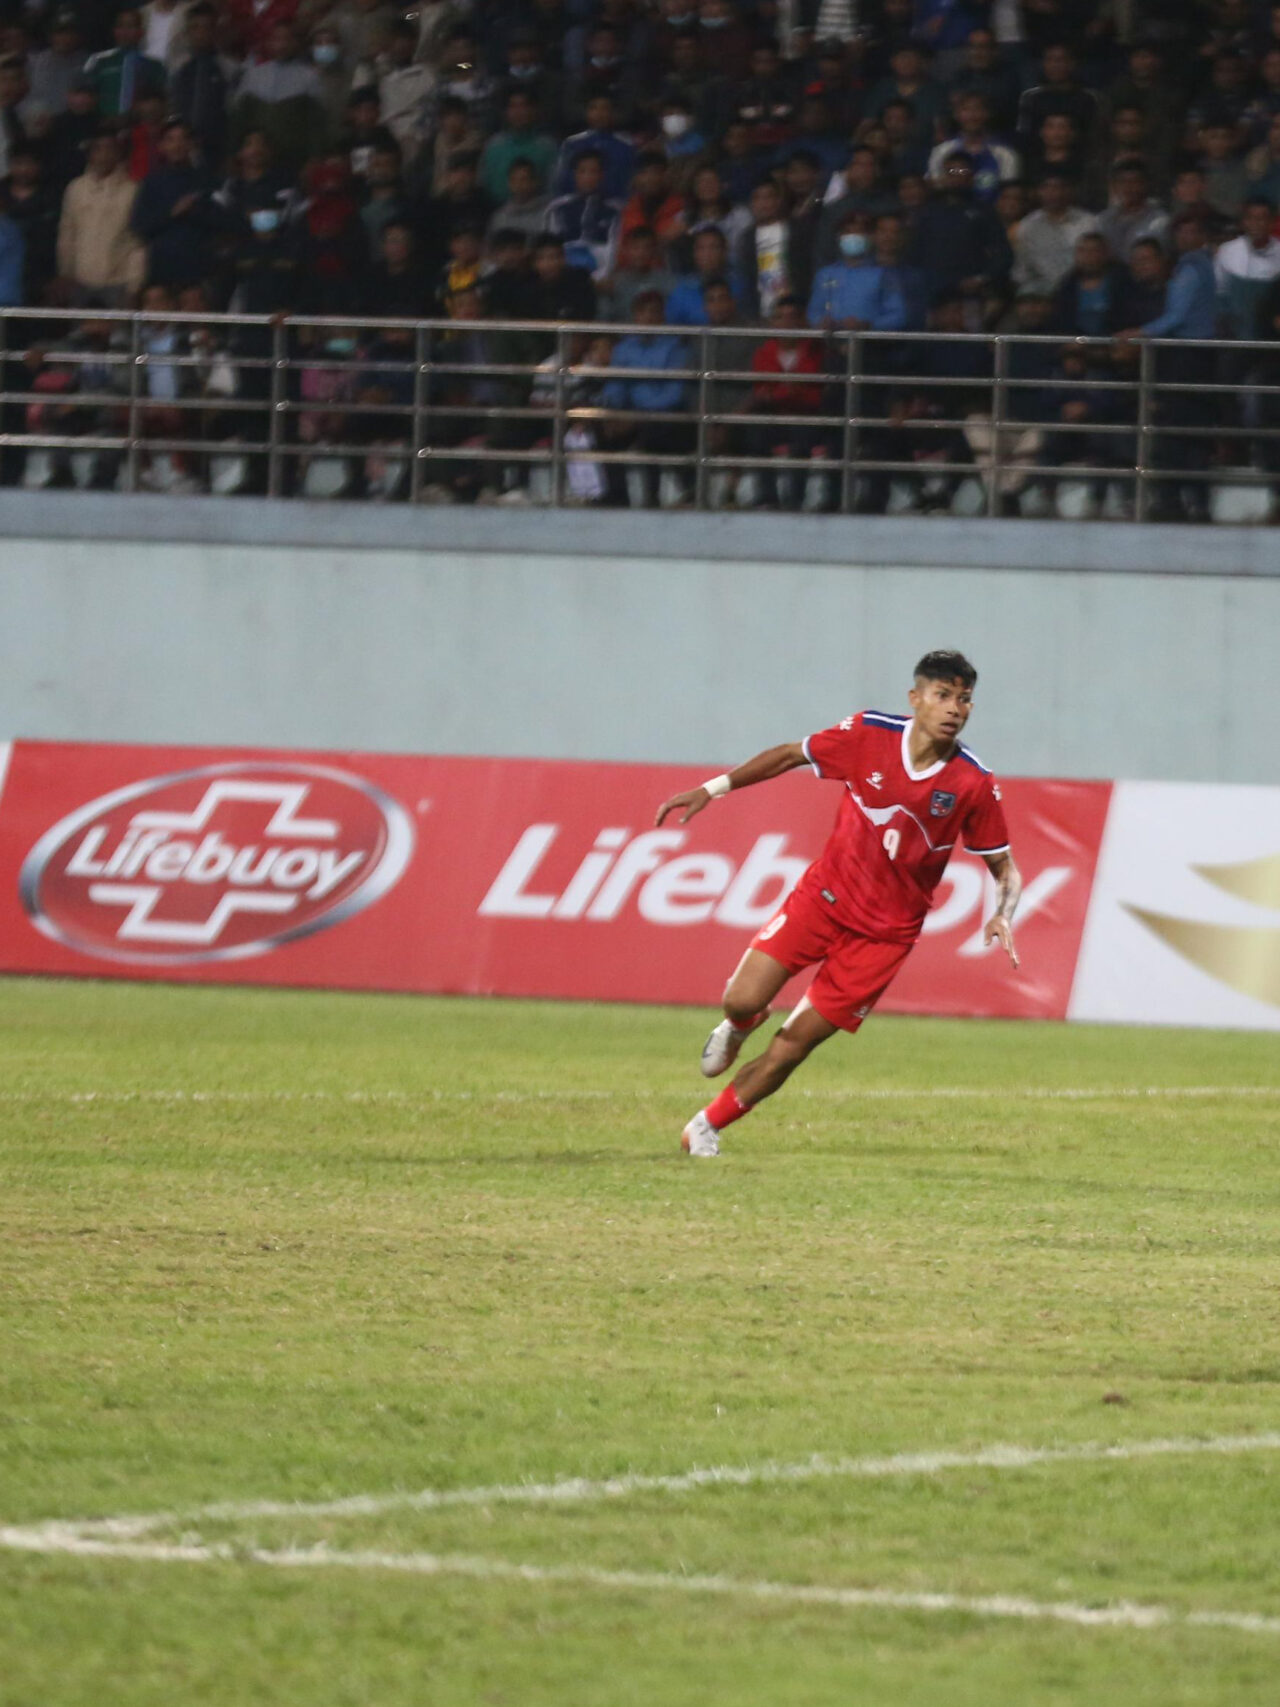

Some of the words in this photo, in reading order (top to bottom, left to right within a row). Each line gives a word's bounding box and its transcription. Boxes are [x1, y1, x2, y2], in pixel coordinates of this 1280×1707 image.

[66, 826, 365, 900] Lifebuoy
[883, 828, 900, 861] 9
[478, 824, 1073, 957] Lifeboy
[759, 914, 788, 941] 9
